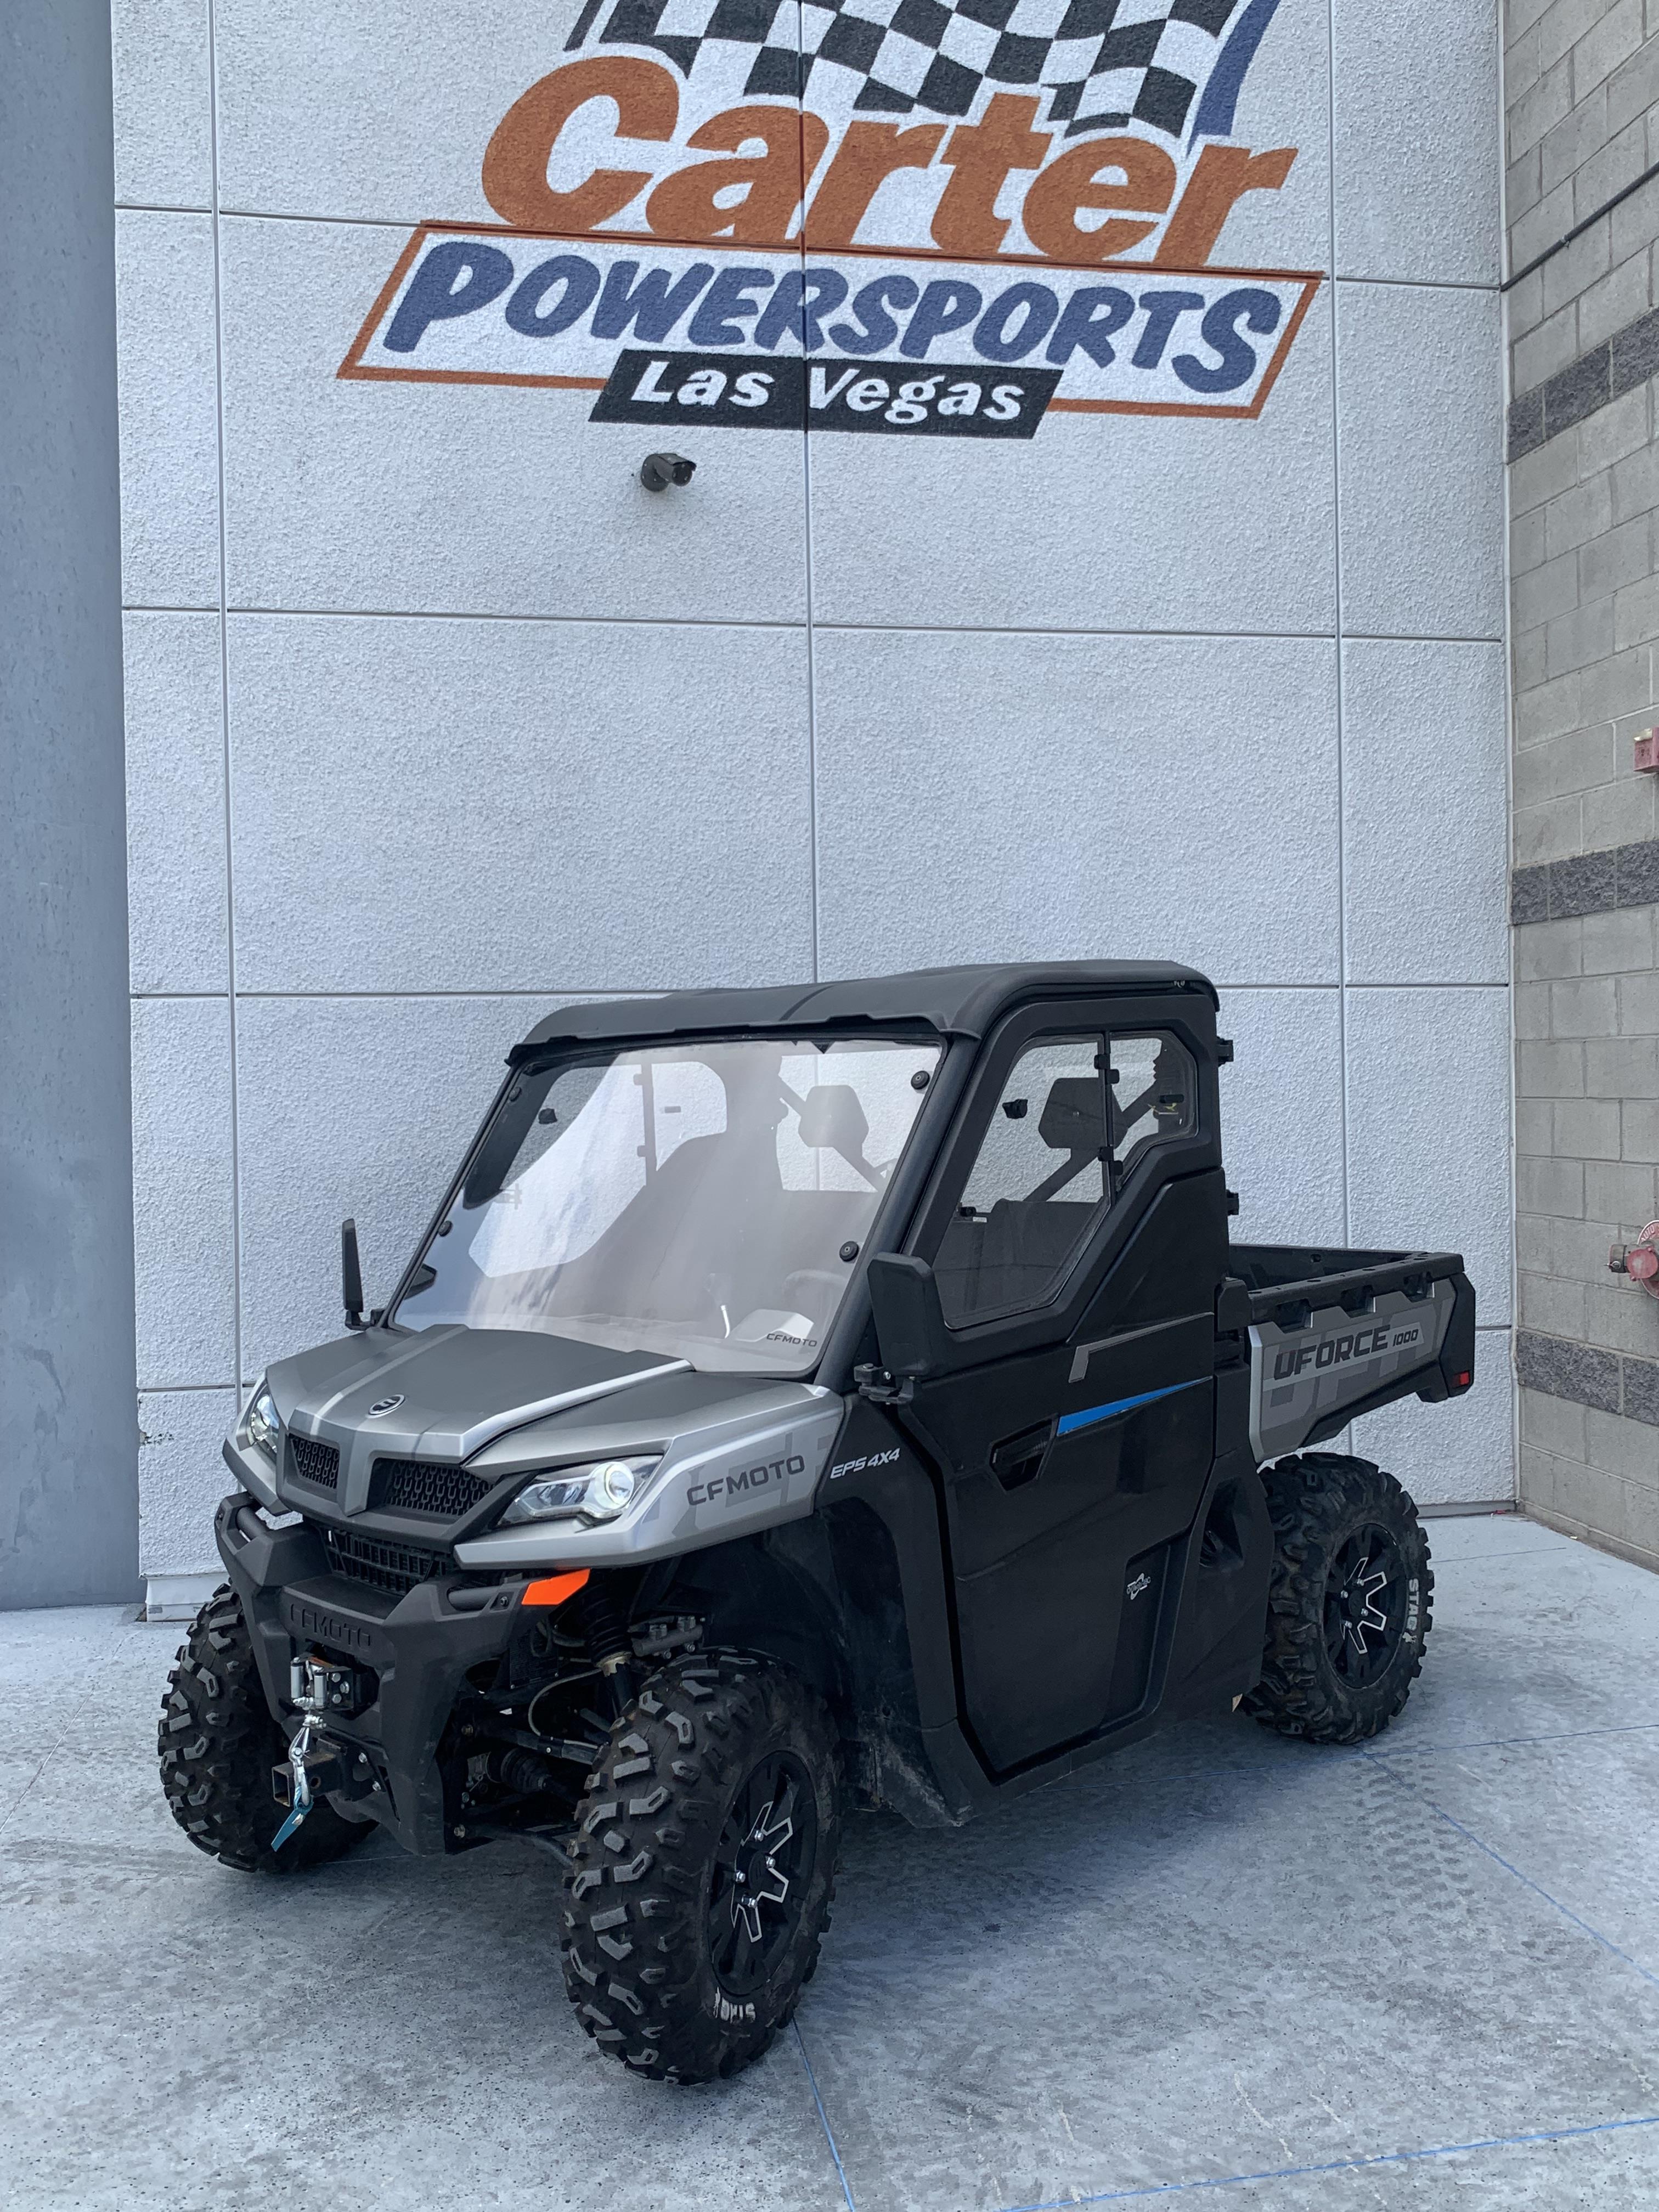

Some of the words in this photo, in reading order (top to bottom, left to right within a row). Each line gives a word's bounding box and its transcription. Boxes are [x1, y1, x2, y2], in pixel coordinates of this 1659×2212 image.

[481, 55, 1299, 268] Carter
[383, 240, 1282, 394] POWERSPORTS
[630, 359, 774, 410] Las
[806, 364, 1026, 425] Vegas
[766, 1333, 817, 1347] CFMOTO
[1274, 1324, 1390, 1380] UFORCE
[1392, 1329, 1419, 1347] 1000
[686, 1455, 805, 1506] CFMOTO
[830, 1456, 867, 1480] EPS
[866, 1447, 900, 1467] 4X4
[291, 1604, 371, 1652] CFMOTO
[1406, 1578, 1419, 1630] STAG
